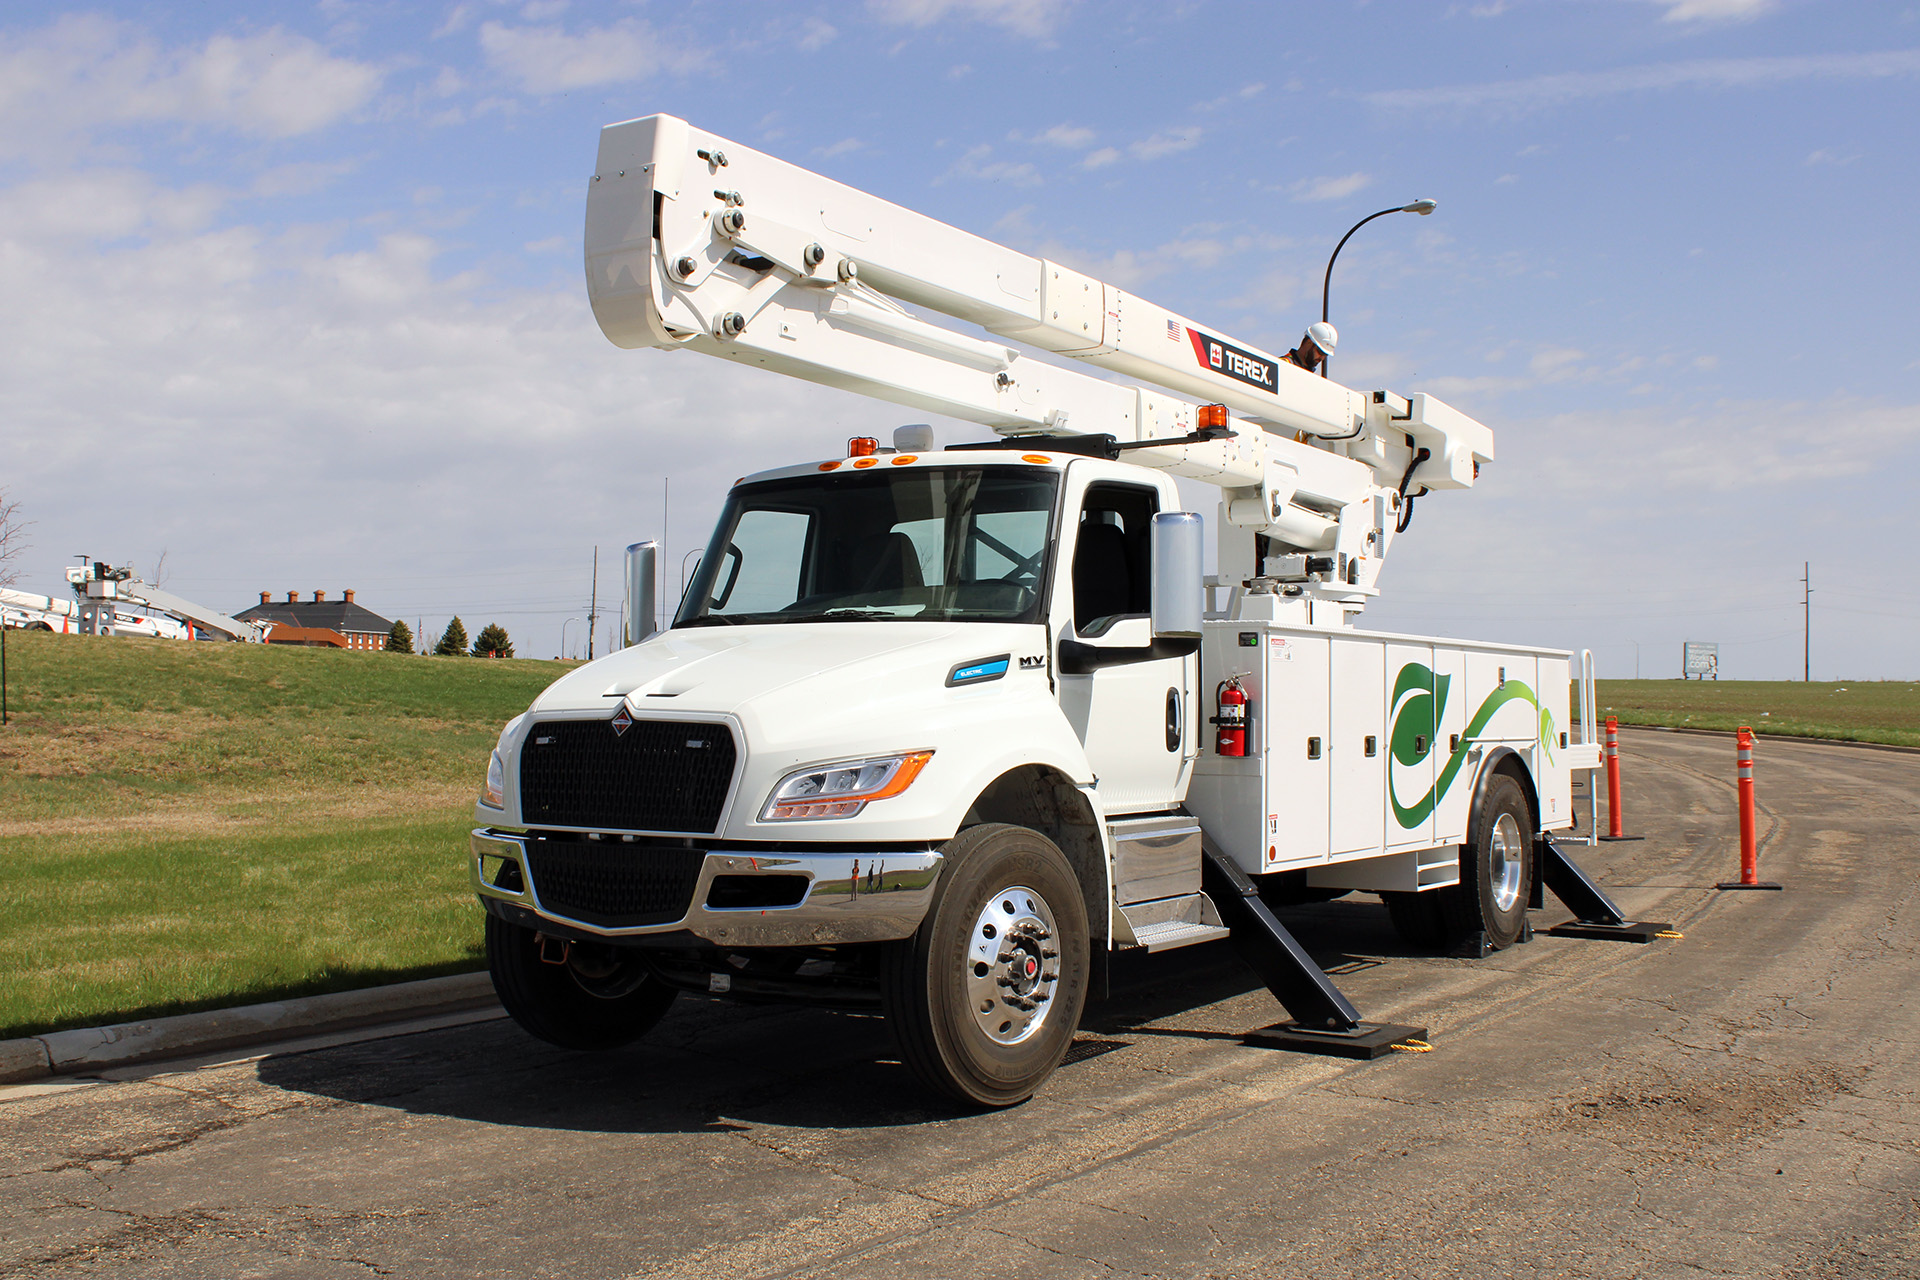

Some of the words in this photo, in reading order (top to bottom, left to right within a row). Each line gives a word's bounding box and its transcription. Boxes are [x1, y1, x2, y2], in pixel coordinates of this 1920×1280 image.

[1225, 349, 1270, 386] TEREX
[1019, 655, 1044, 666] MV
[960, 668, 983, 677] ELECTRIC
